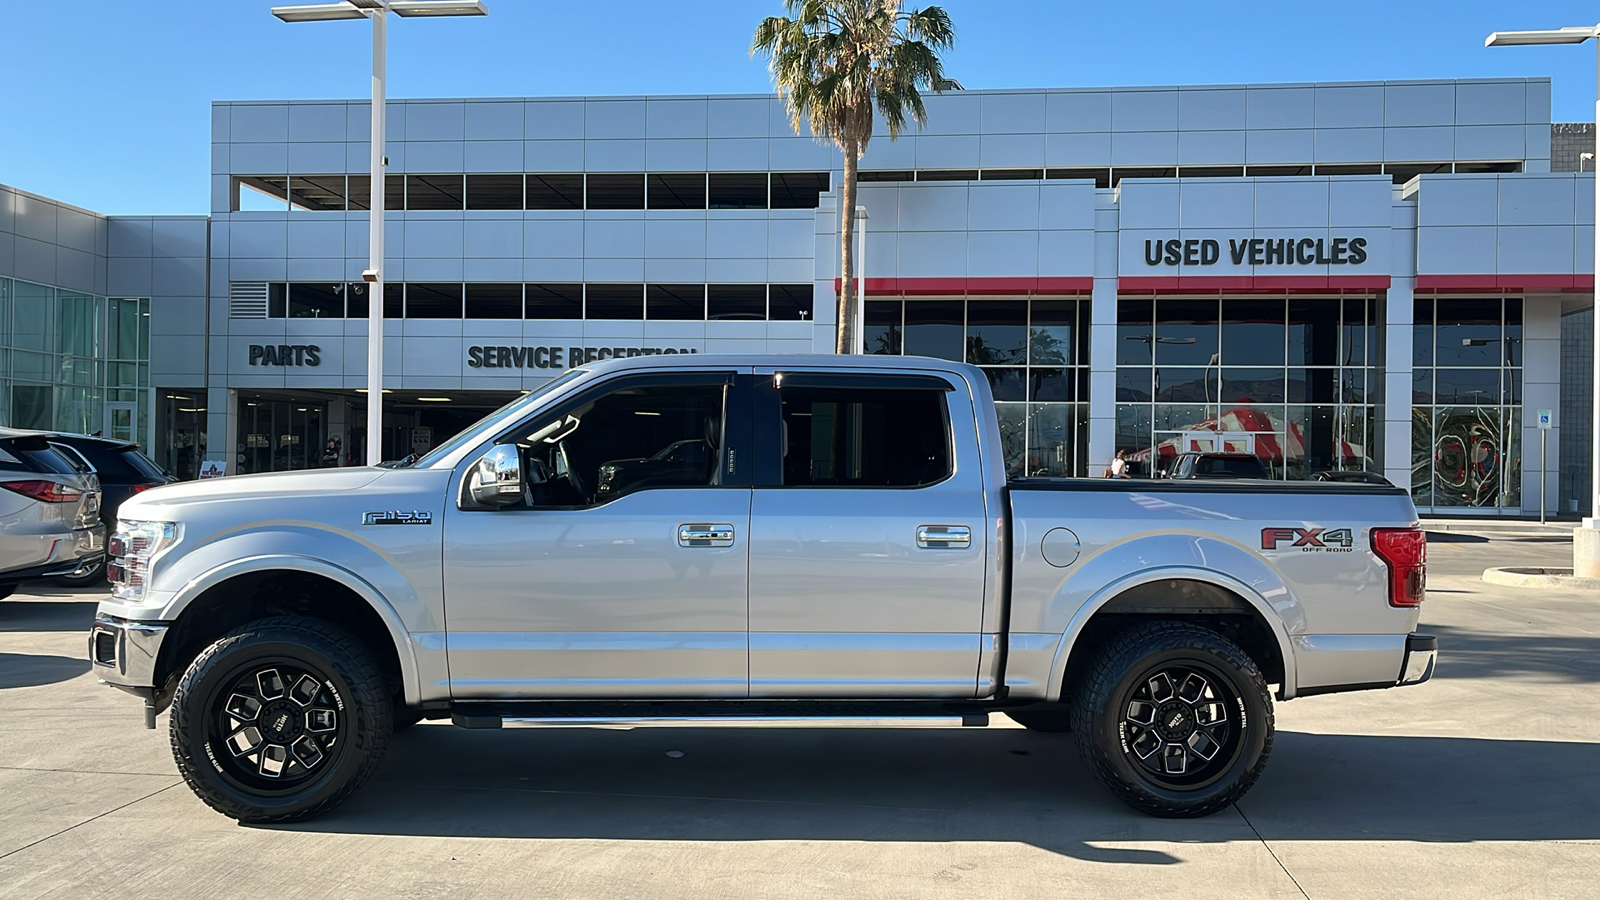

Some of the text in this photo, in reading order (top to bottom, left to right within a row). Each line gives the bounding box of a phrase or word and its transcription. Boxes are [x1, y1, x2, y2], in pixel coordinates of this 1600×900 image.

[1145, 238, 1367, 265] USED VEHICLES
[249, 345, 321, 366] PARTS
[467, 346, 697, 368] SERVICE RECEP
[1261, 527, 1353, 549] FX4
[325, 680, 344, 711] MOTO METAL
[1236, 696, 1244, 711] MOTO
